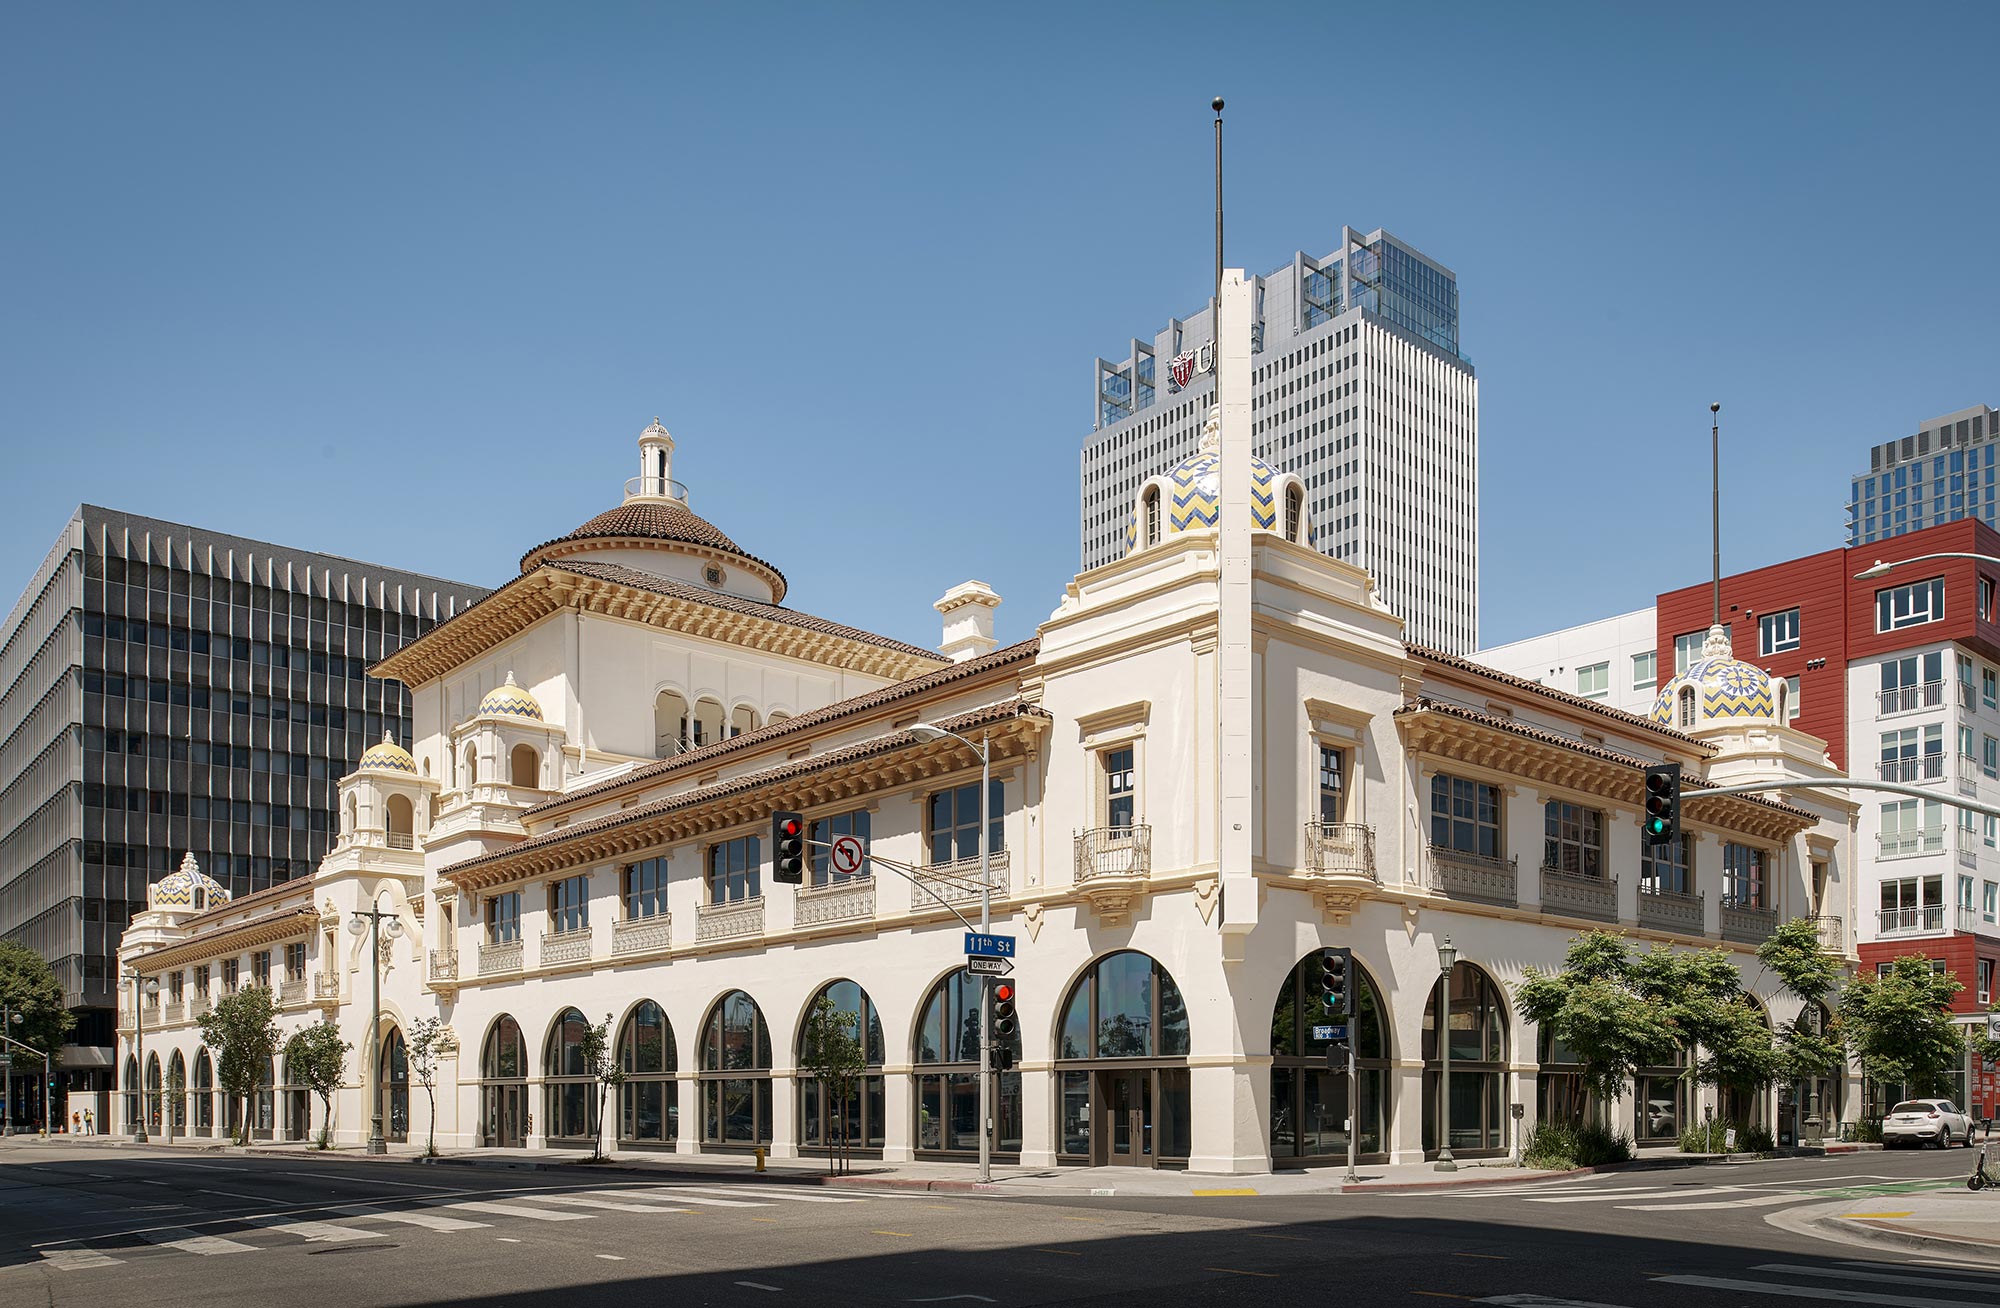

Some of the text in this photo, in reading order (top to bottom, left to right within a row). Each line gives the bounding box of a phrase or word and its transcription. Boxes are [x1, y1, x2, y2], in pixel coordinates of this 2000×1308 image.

[1195, 339, 1216, 373] U
[970, 937, 1011, 953] 11th St
[973, 961, 1002, 970] ONE WAY
